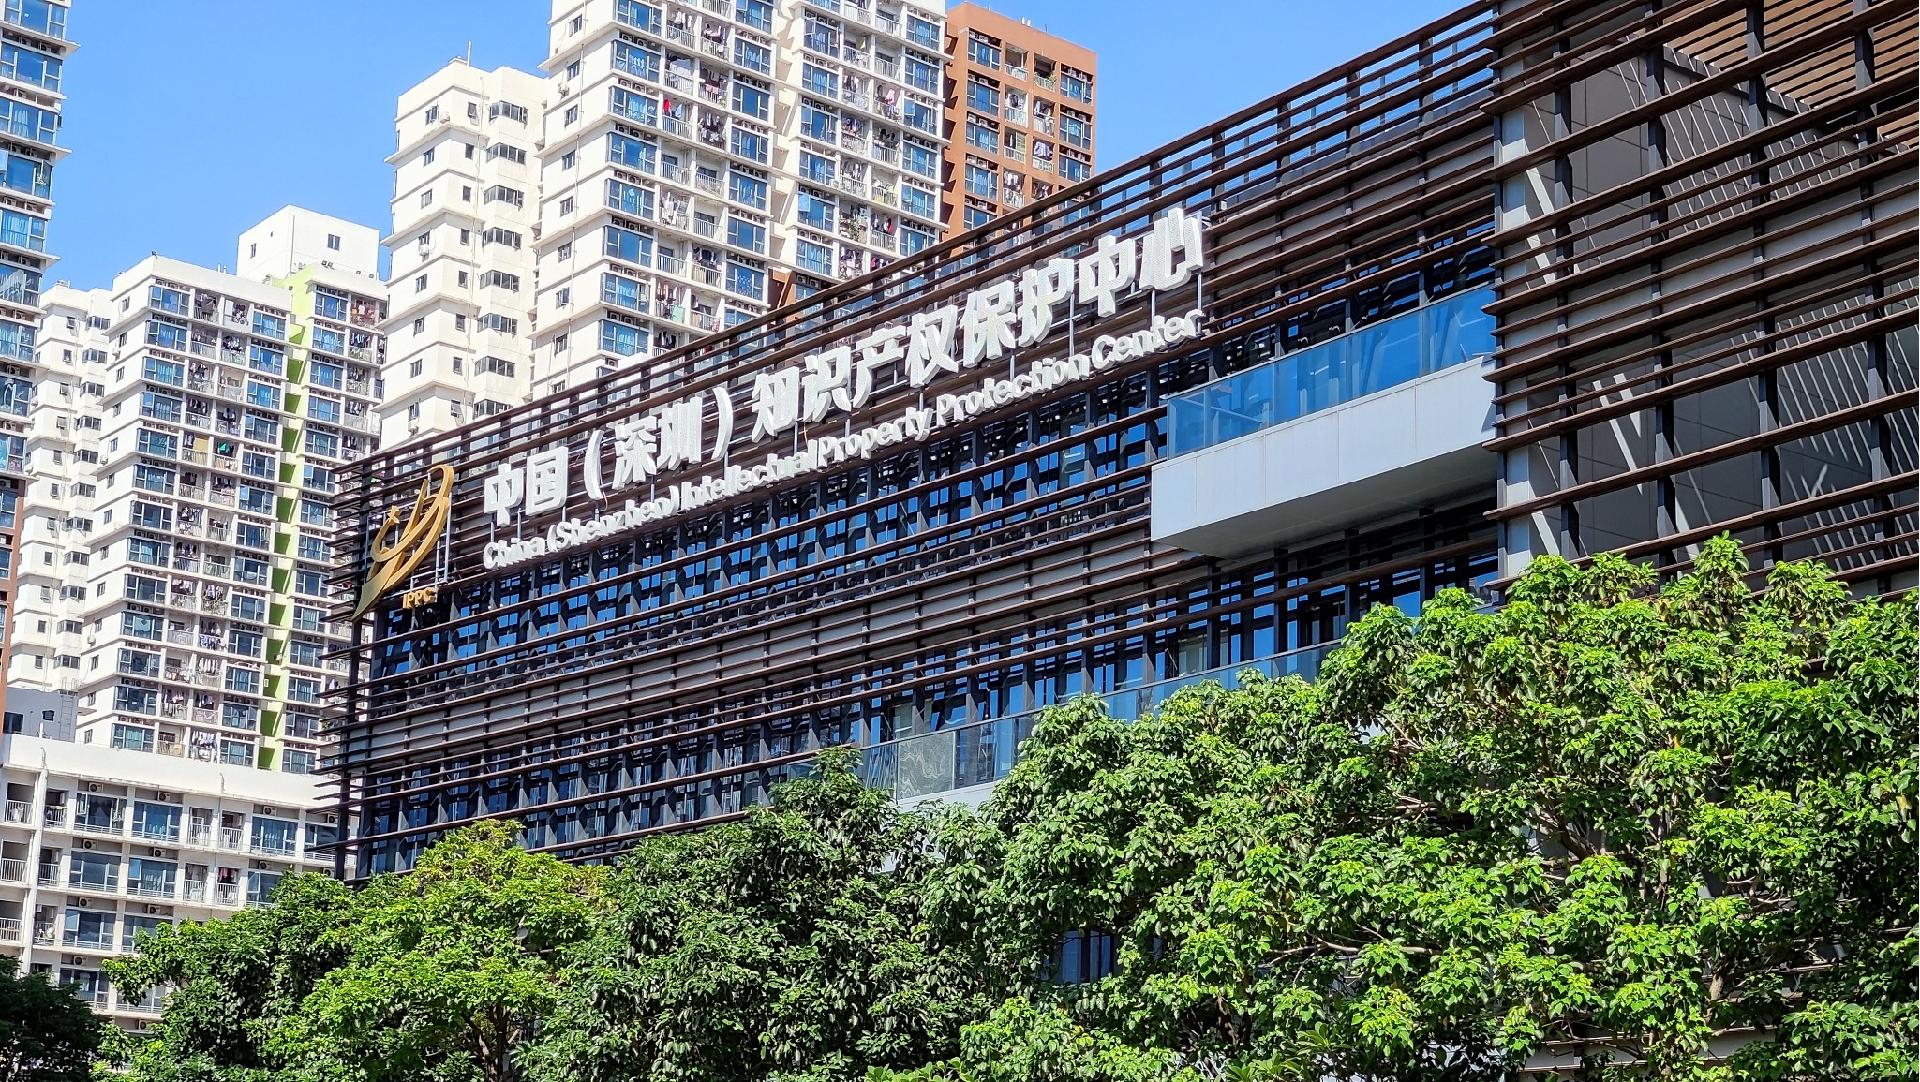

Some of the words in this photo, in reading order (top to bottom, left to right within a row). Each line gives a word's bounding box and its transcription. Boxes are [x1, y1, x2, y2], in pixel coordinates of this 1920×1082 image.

[484, 536, 545, 570] China
[547, 485, 679, 552] (Shenzhen)
[681, 438, 817, 511] Intellectual
[818, 407, 933, 467] Property
[936, 354, 1090, 426] Protection
[1092, 309, 1202, 370] Center
[403, 587, 437, 609] IPPC
